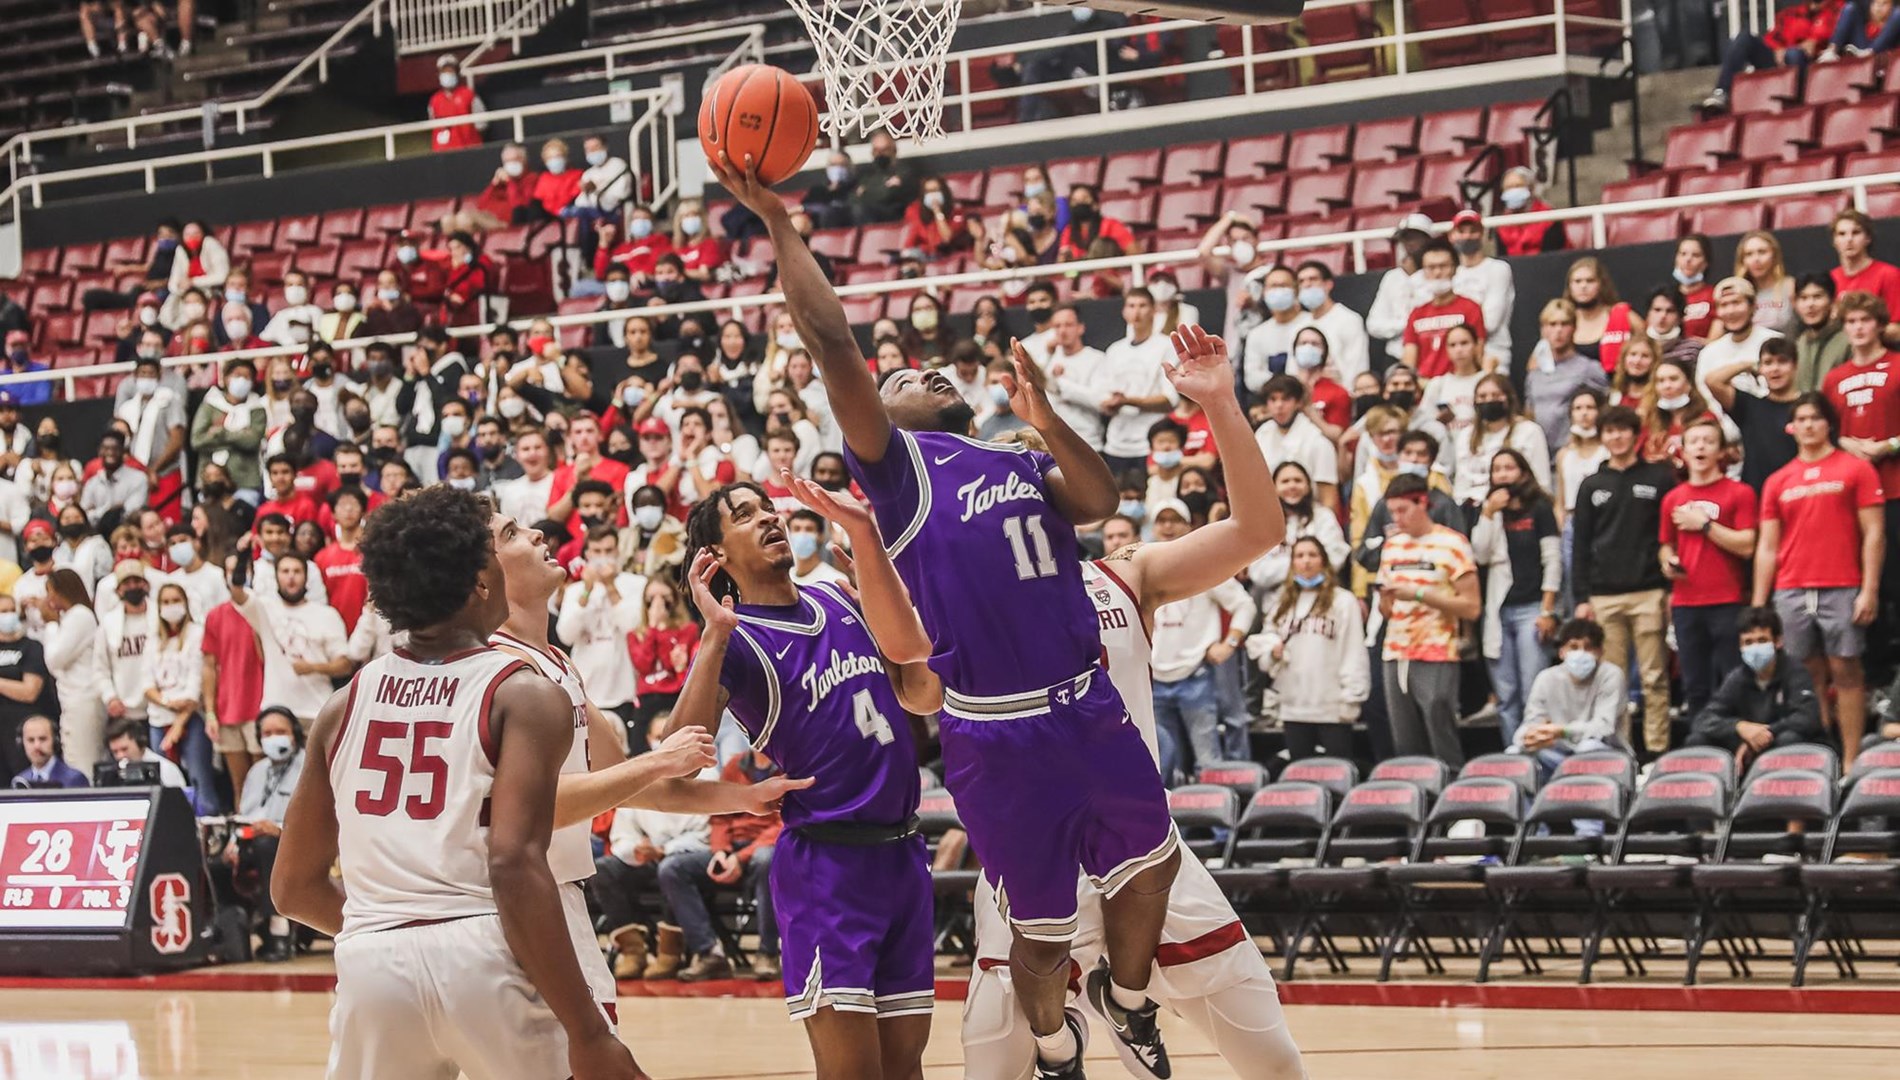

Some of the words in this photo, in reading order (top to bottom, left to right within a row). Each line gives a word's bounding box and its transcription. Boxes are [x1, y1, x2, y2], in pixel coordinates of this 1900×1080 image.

[1002, 514, 1059, 581] 11
[375, 674, 460, 707] INGRAM
[801, 648, 885, 713] Tarleton
[852, 688, 896, 747] 4
[355, 719, 455, 820] 55
[20, 829, 74, 873] 28
[3, 887, 34, 907] FLS
[49, 886, 63, 909] 0
[115, 886, 131, 908] 3
